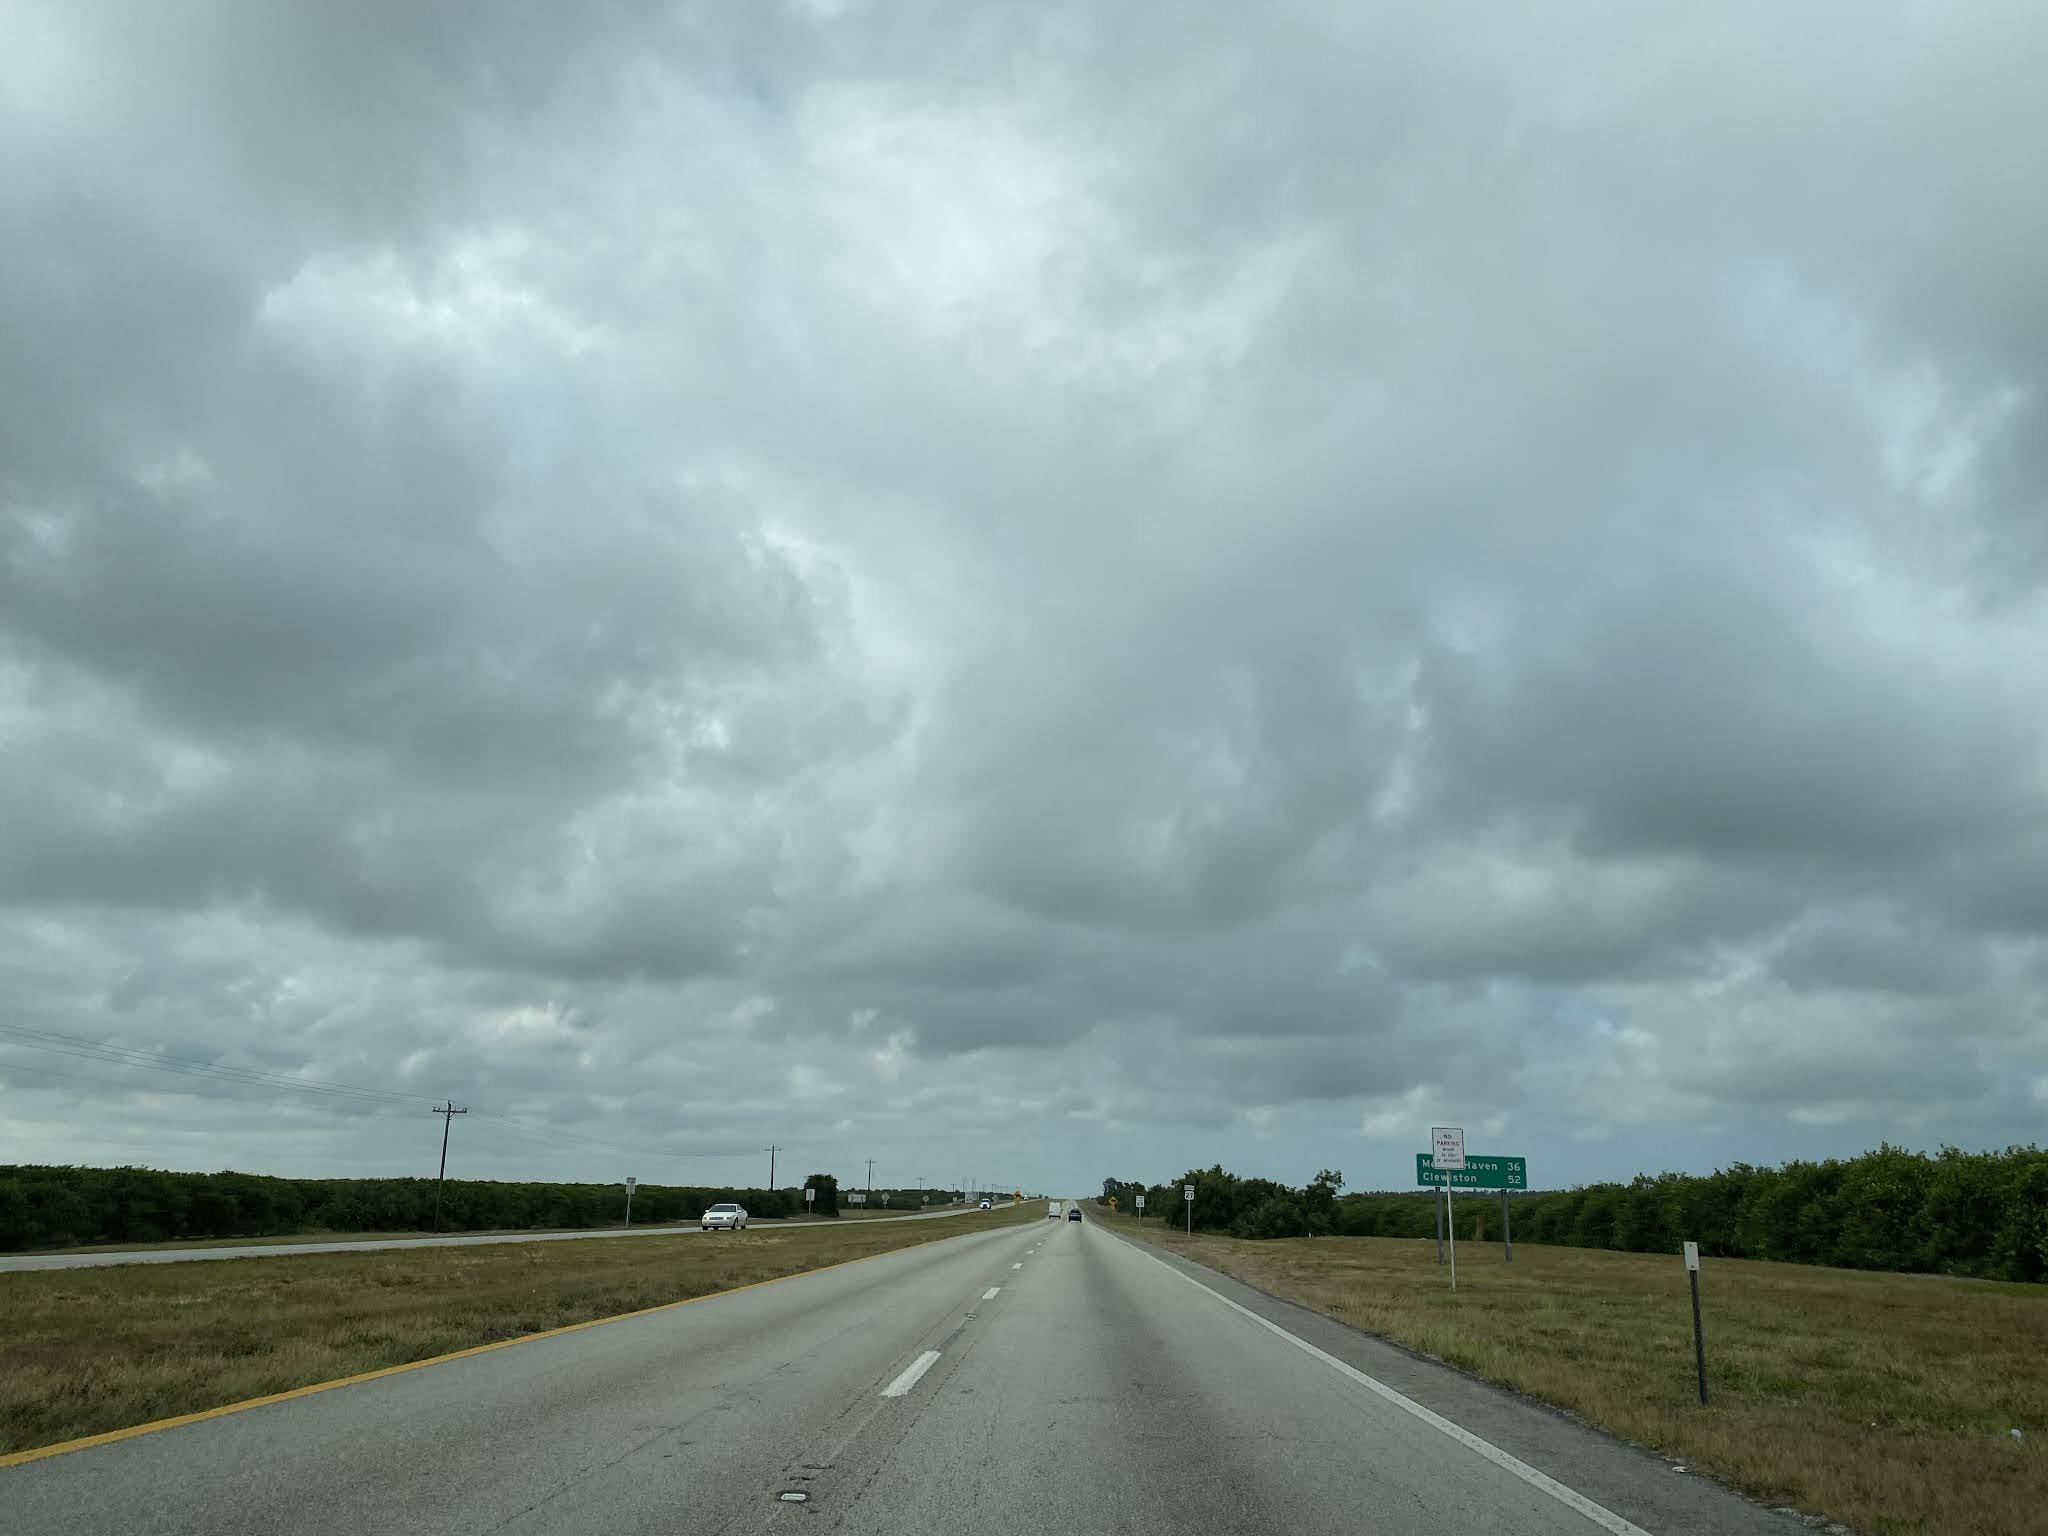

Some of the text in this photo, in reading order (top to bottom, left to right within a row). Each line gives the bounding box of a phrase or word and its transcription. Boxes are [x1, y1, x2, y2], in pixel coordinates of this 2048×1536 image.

[1464, 1161, 1521, 1171] Haven 36
[1507, 1175, 1521, 1184] 52
